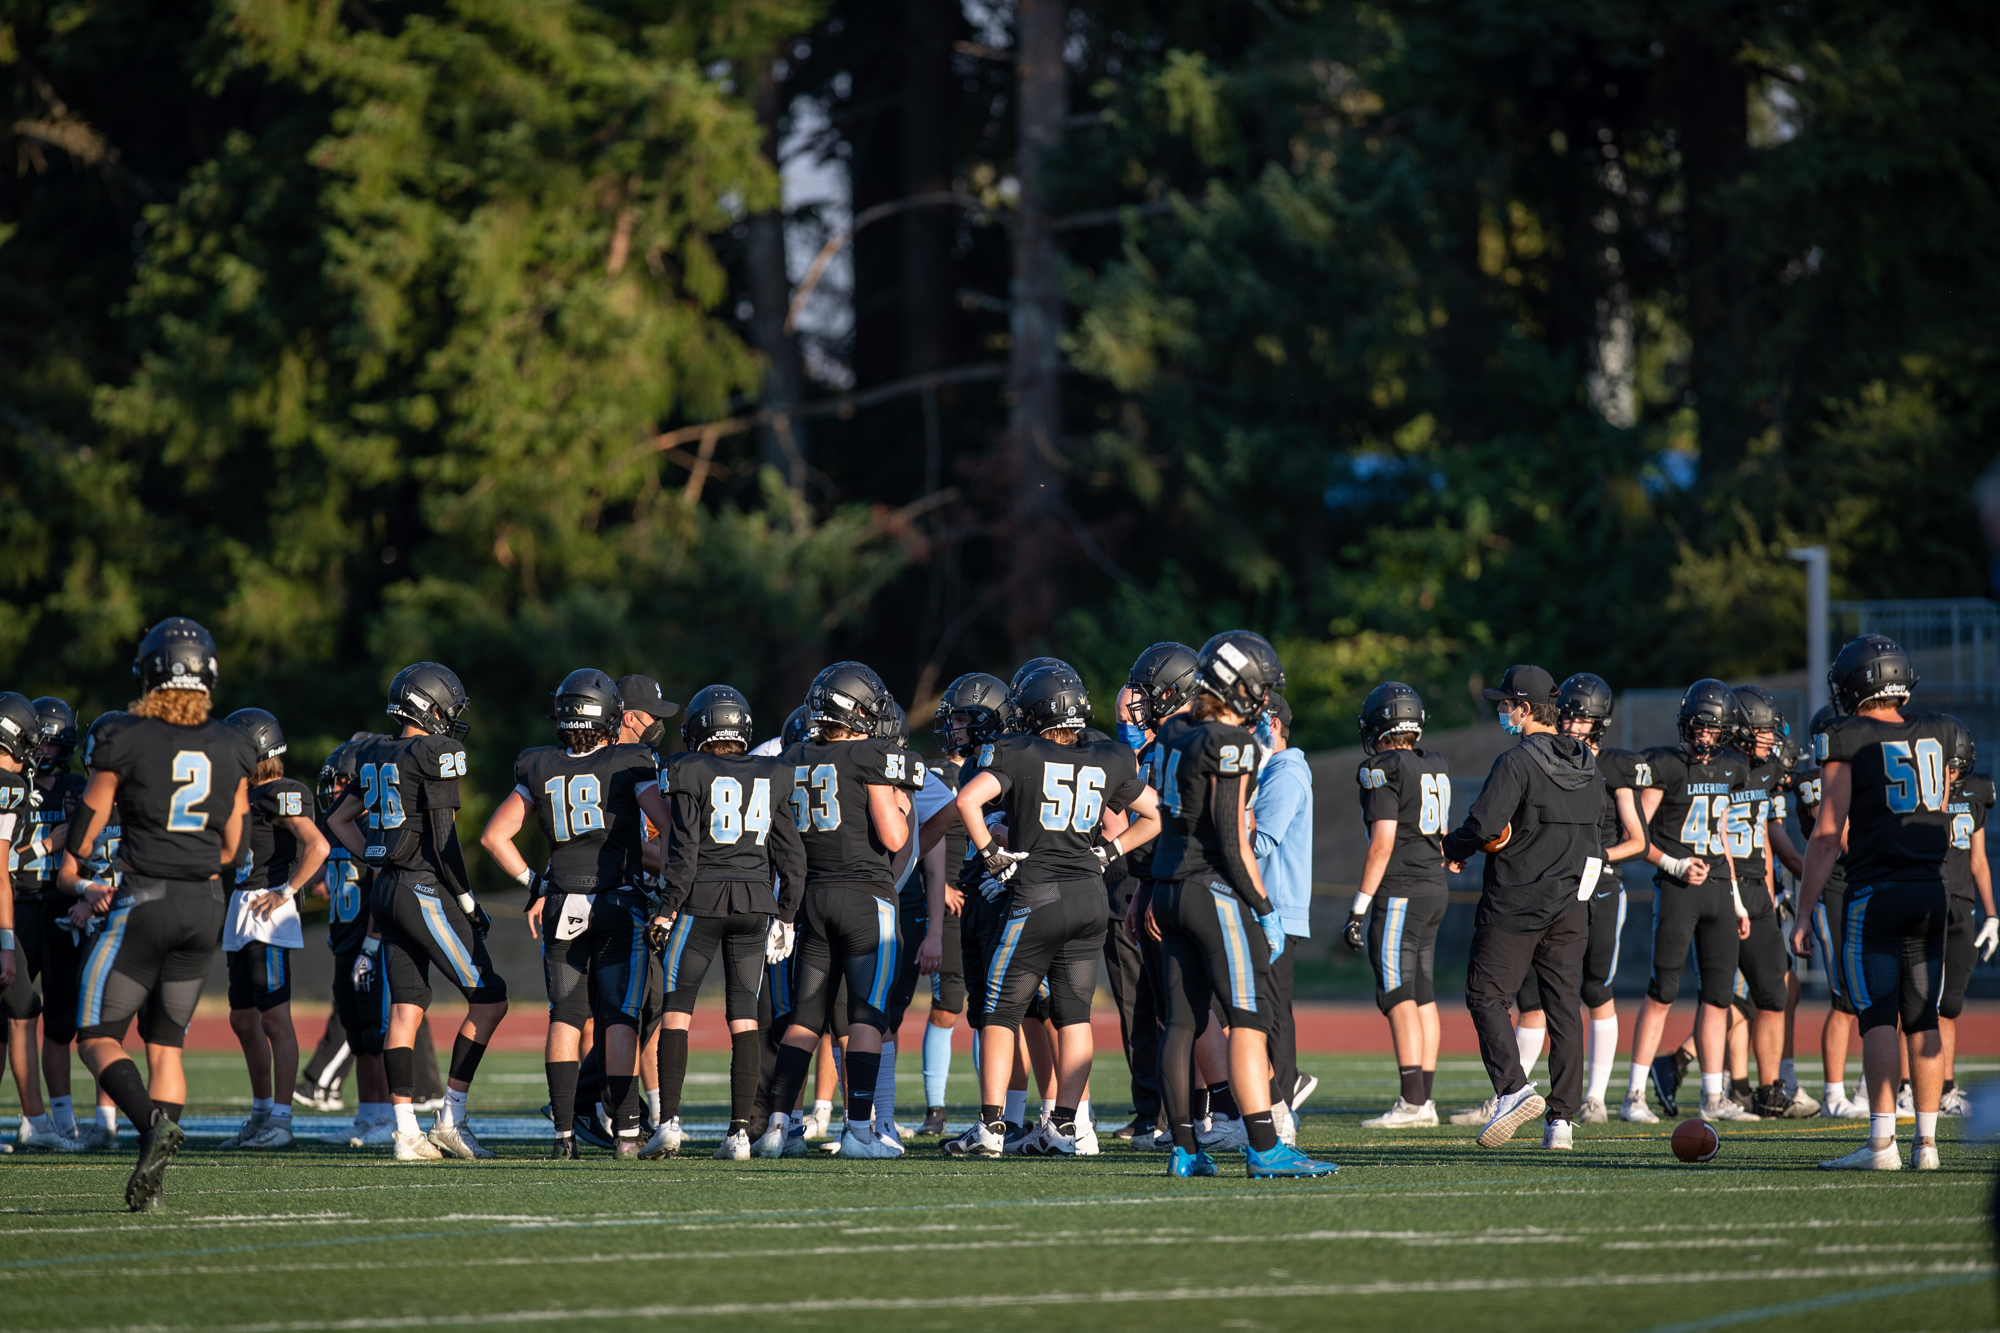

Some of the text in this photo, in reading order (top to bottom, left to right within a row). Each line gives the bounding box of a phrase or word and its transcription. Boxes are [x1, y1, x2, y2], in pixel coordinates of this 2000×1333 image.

[560, 720, 592, 729] Riddell
[715, 729, 739, 737] schutt
[439, 751, 467, 778] 26
[1219, 744, 1254, 772] 24
[1360, 767, 1387, 789] 60
[1881, 737, 1944, 814] 50
[167, 750, 212, 832] 2
[360, 762, 406, 829] 26
[789, 763, 842, 833] 53
[1039, 761, 1107, 833] 56
[1687, 783, 1729, 796] LAKERIDGE
[1730, 789, 1768, 804] LAKERIDGE
[277, 791, 303, 816] 15
[544, 774, 606, 842] 18
[709, 776, 772, 846] 84
[1419, 773, 1451, 835] 60
[30, 811, 65, 823] LAKER
[414, 883, 435, 895] PACERS
[1210, 881, 1233, 895] PACERS
[1012, 906, 1032, 917] PACERS
